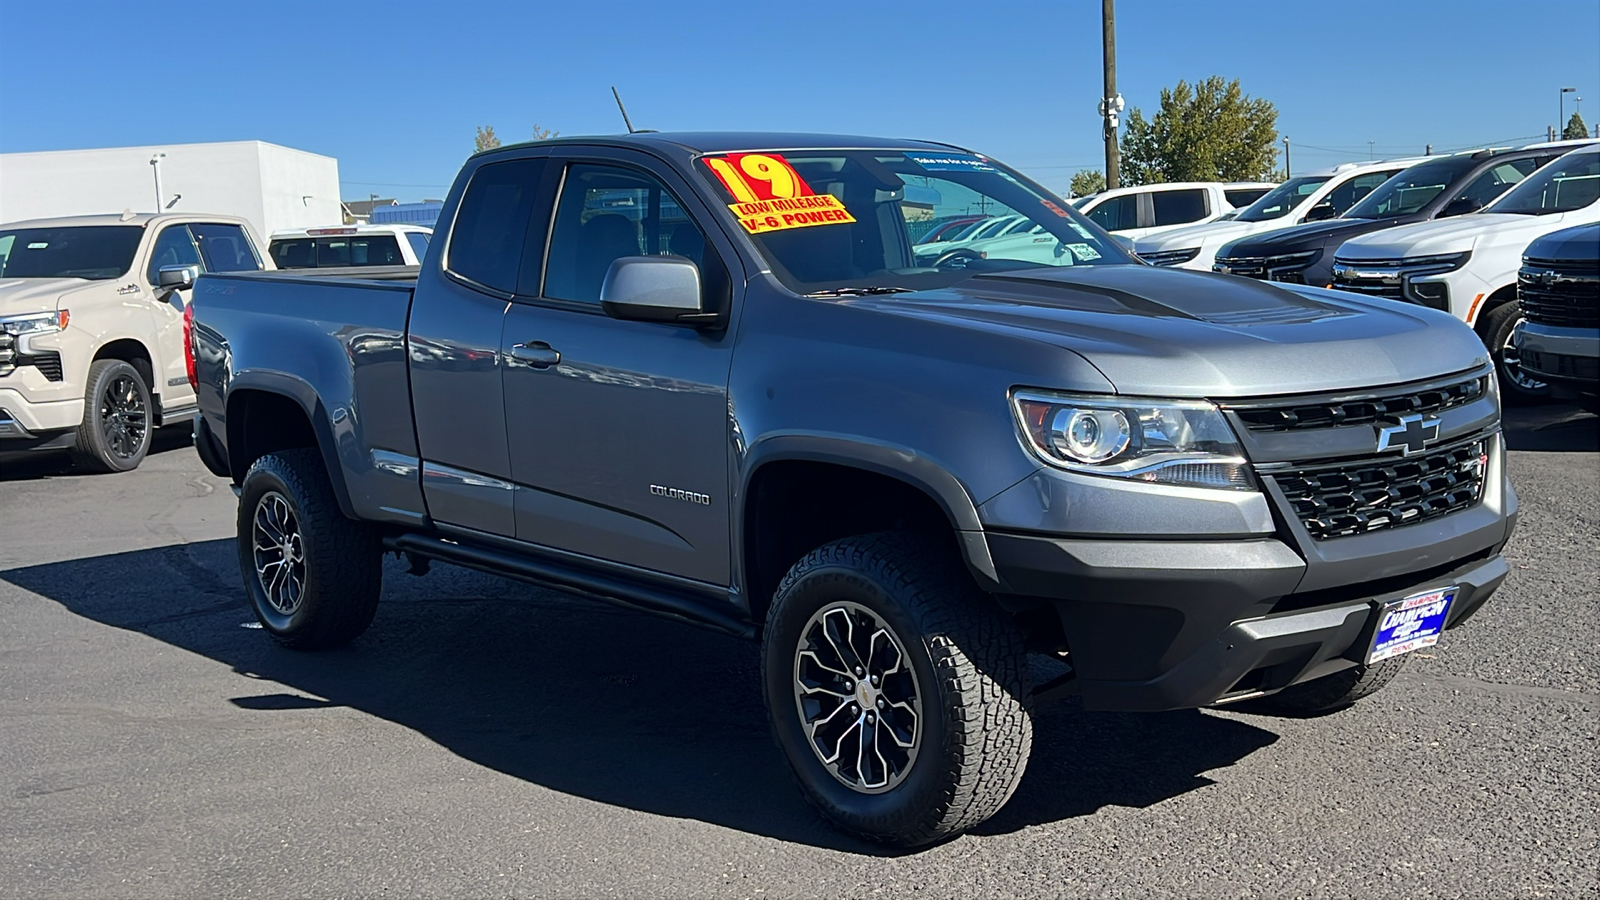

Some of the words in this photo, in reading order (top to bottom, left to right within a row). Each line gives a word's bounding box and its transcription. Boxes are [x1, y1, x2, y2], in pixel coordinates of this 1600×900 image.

[709, 154, 801, 203] 19
[737, 202, 773, 215] LOW
[773, 196, 834, 211] MILEAGE
[743, 215, 780, 231] V-6
[782, 209, 848, 226] POWER
[649, 484, 710, 506] COLORADO
[1404, 594, 1440, 608] CHAMPION
[1380, 600, 1447, 632] CHAMPION
[1391, 642, 1414, 655] RENO
